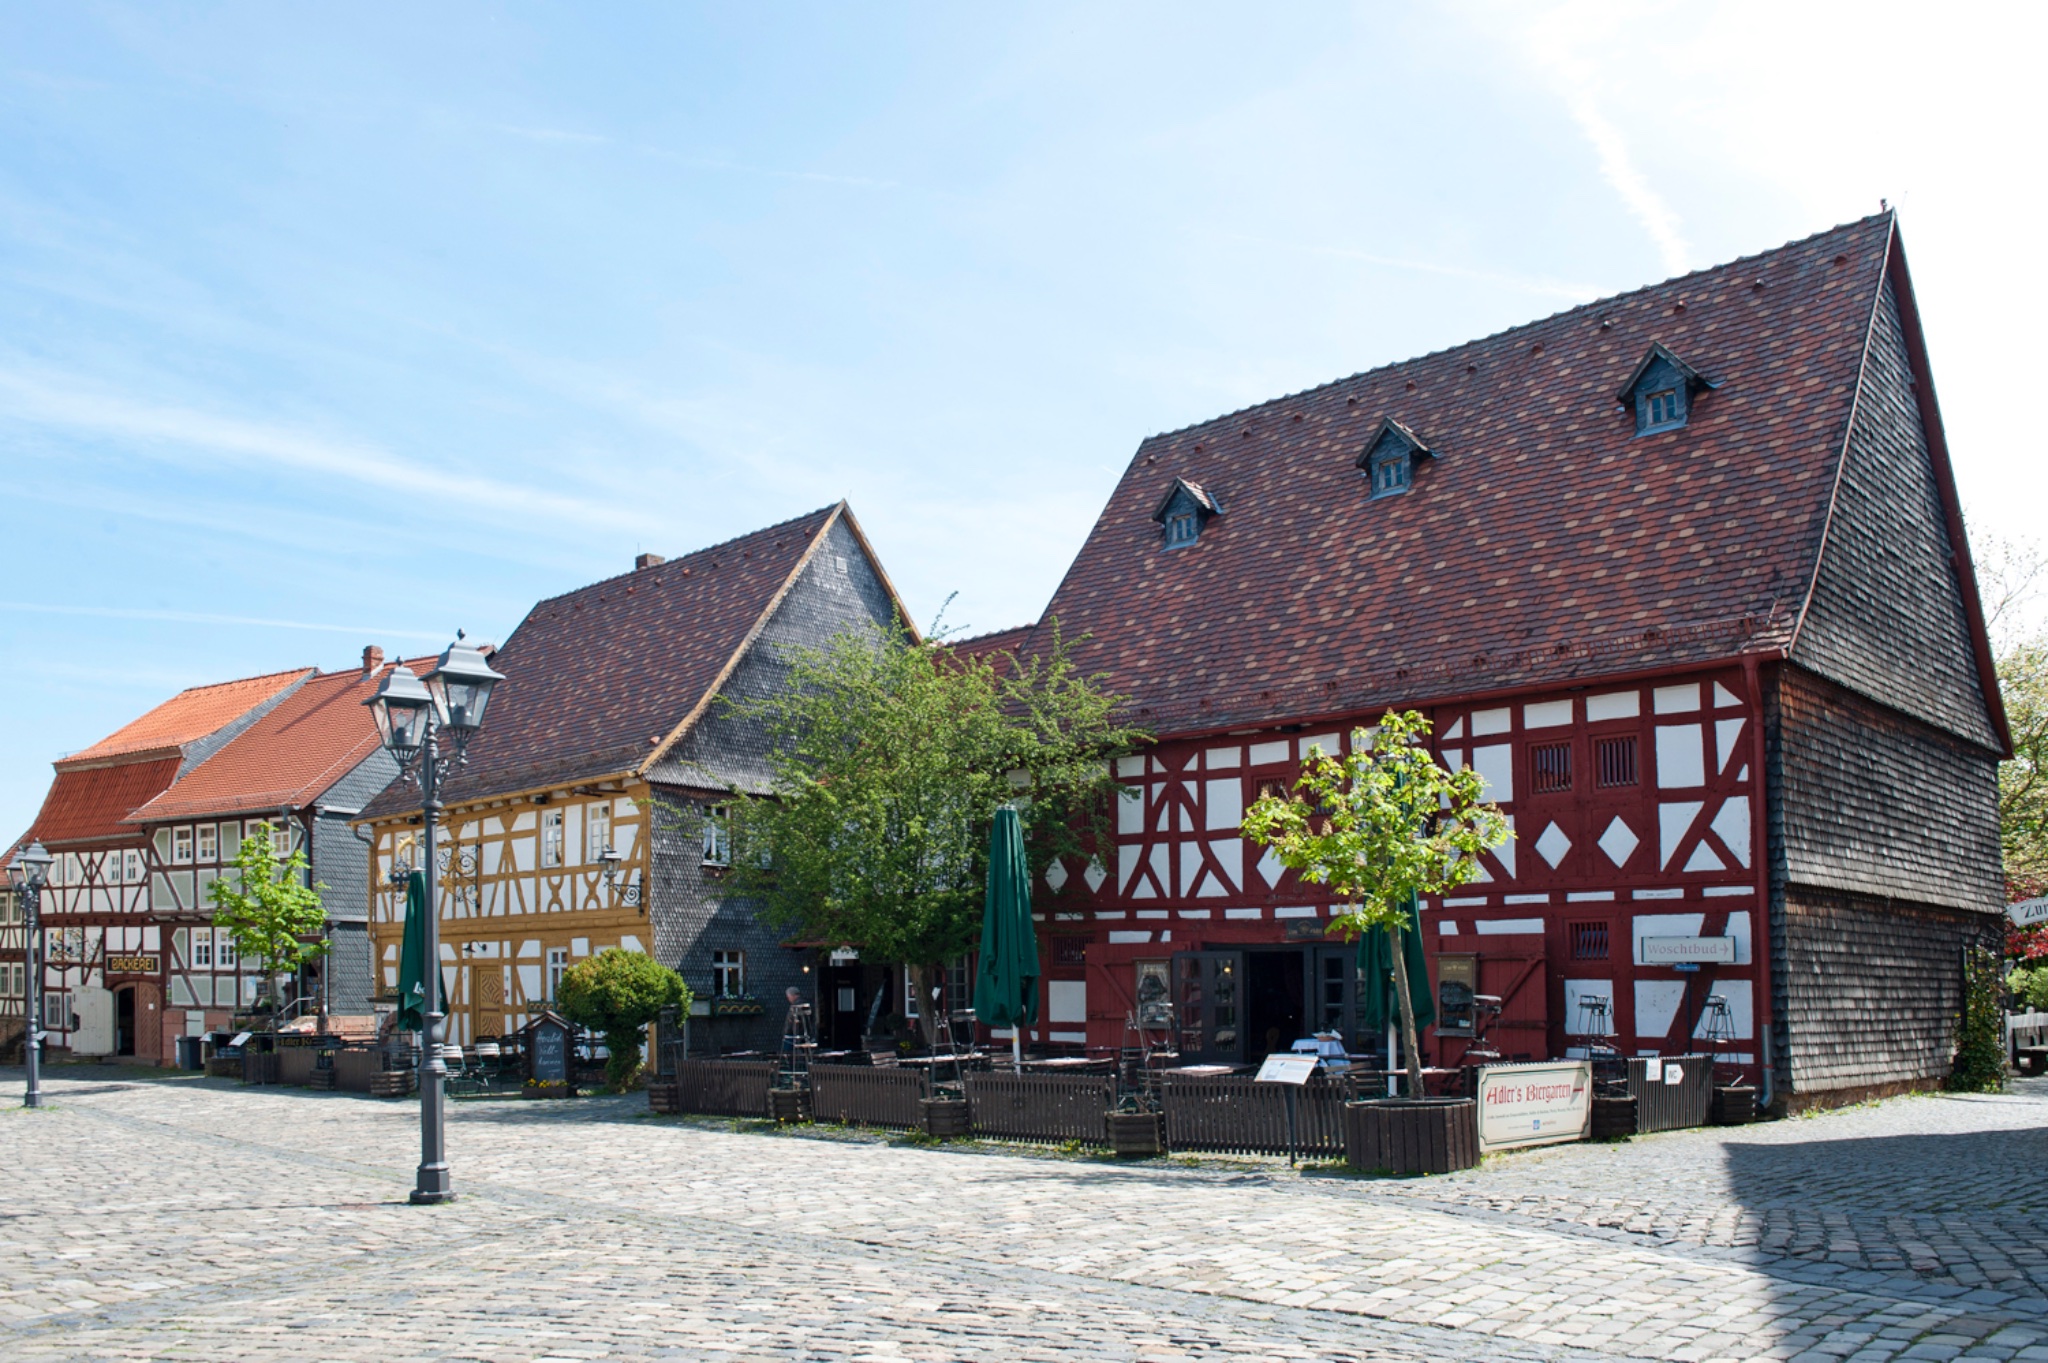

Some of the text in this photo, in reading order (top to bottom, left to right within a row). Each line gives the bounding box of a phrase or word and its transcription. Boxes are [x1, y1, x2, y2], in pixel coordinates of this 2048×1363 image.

[1647, 943, 1717, 955] Woschtbud
[1486, 1083, 1571, 1106] Adler's Biergarten
